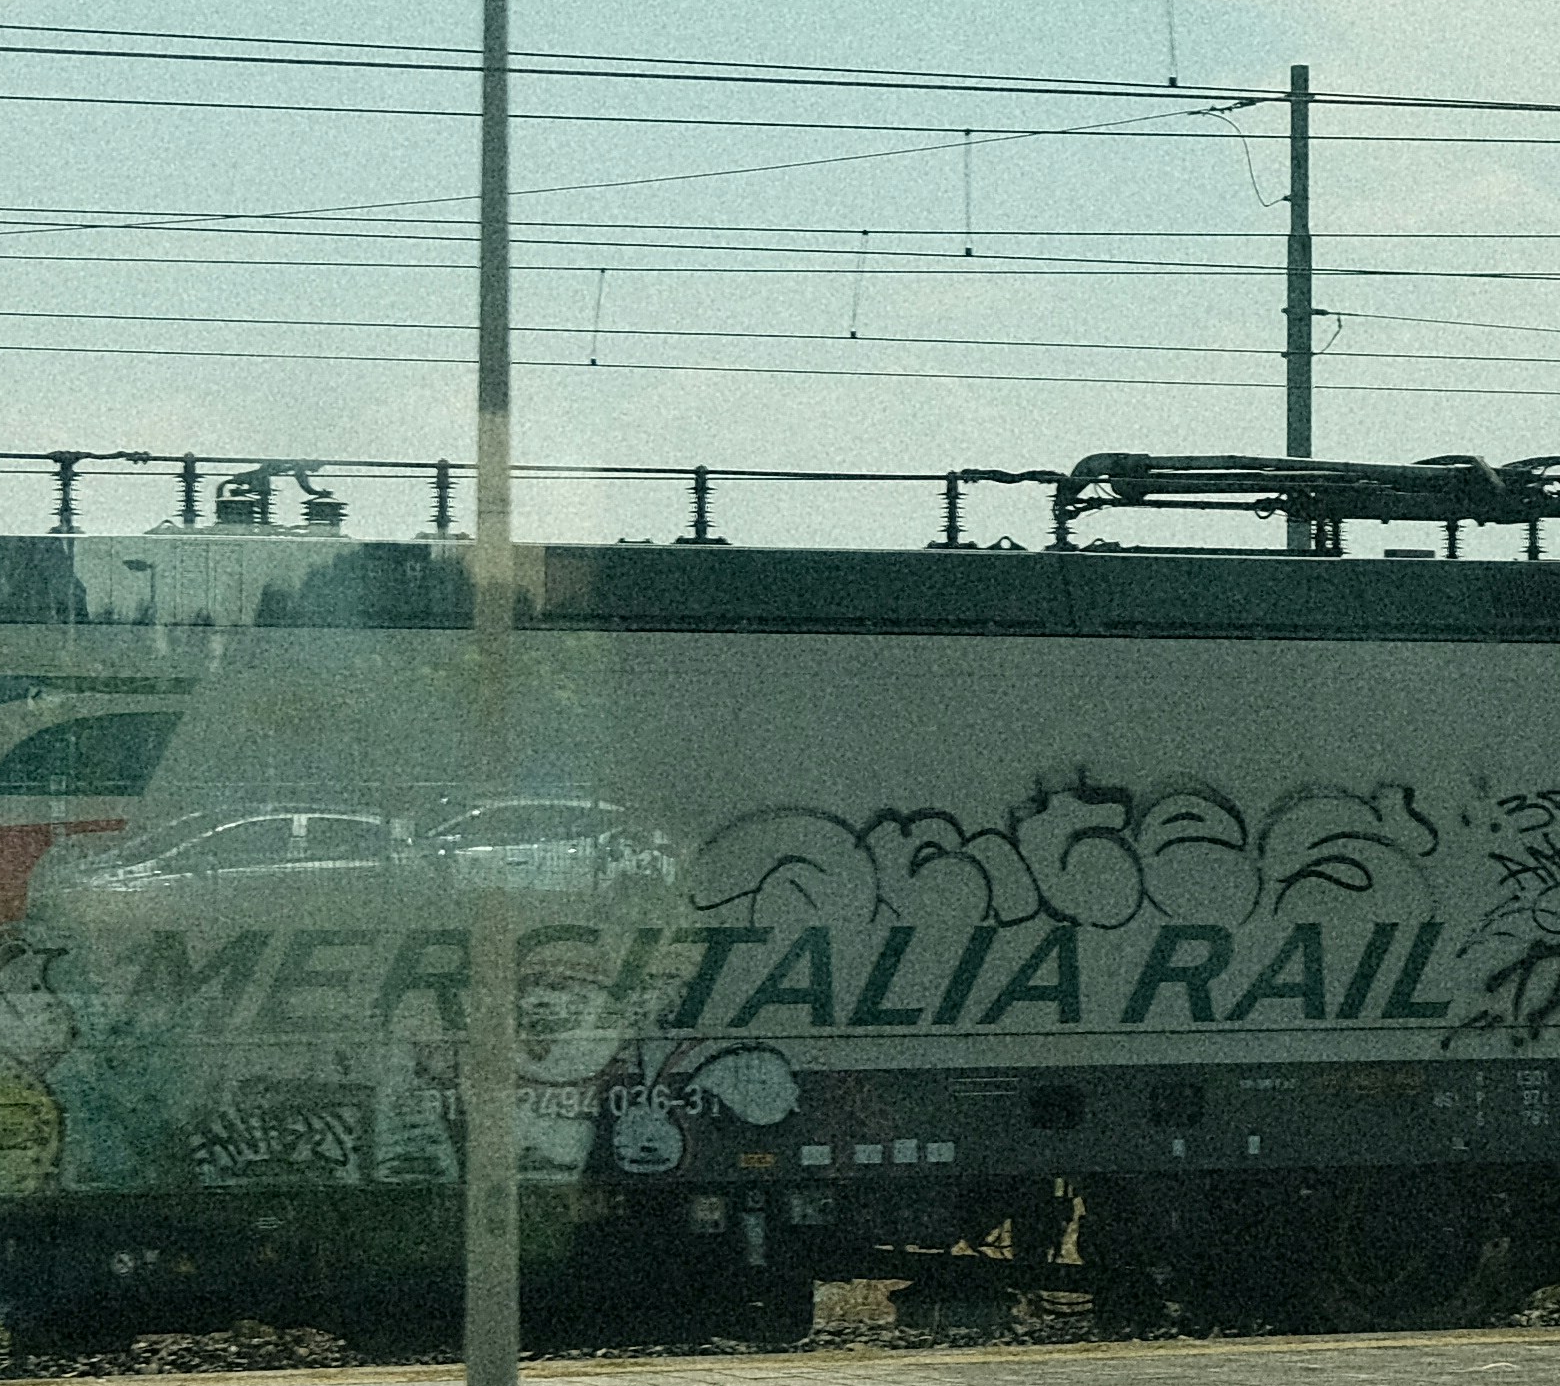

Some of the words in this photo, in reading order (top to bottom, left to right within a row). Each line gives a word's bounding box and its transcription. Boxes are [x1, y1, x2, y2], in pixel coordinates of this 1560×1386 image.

[122, 922, 1082, 1031] MERCITALIA
[1120, 920, 1456, 1025] RAIL
[516, 1085, 601, 1119] 2494
[608, 1083, 706, 1118] 036-3
